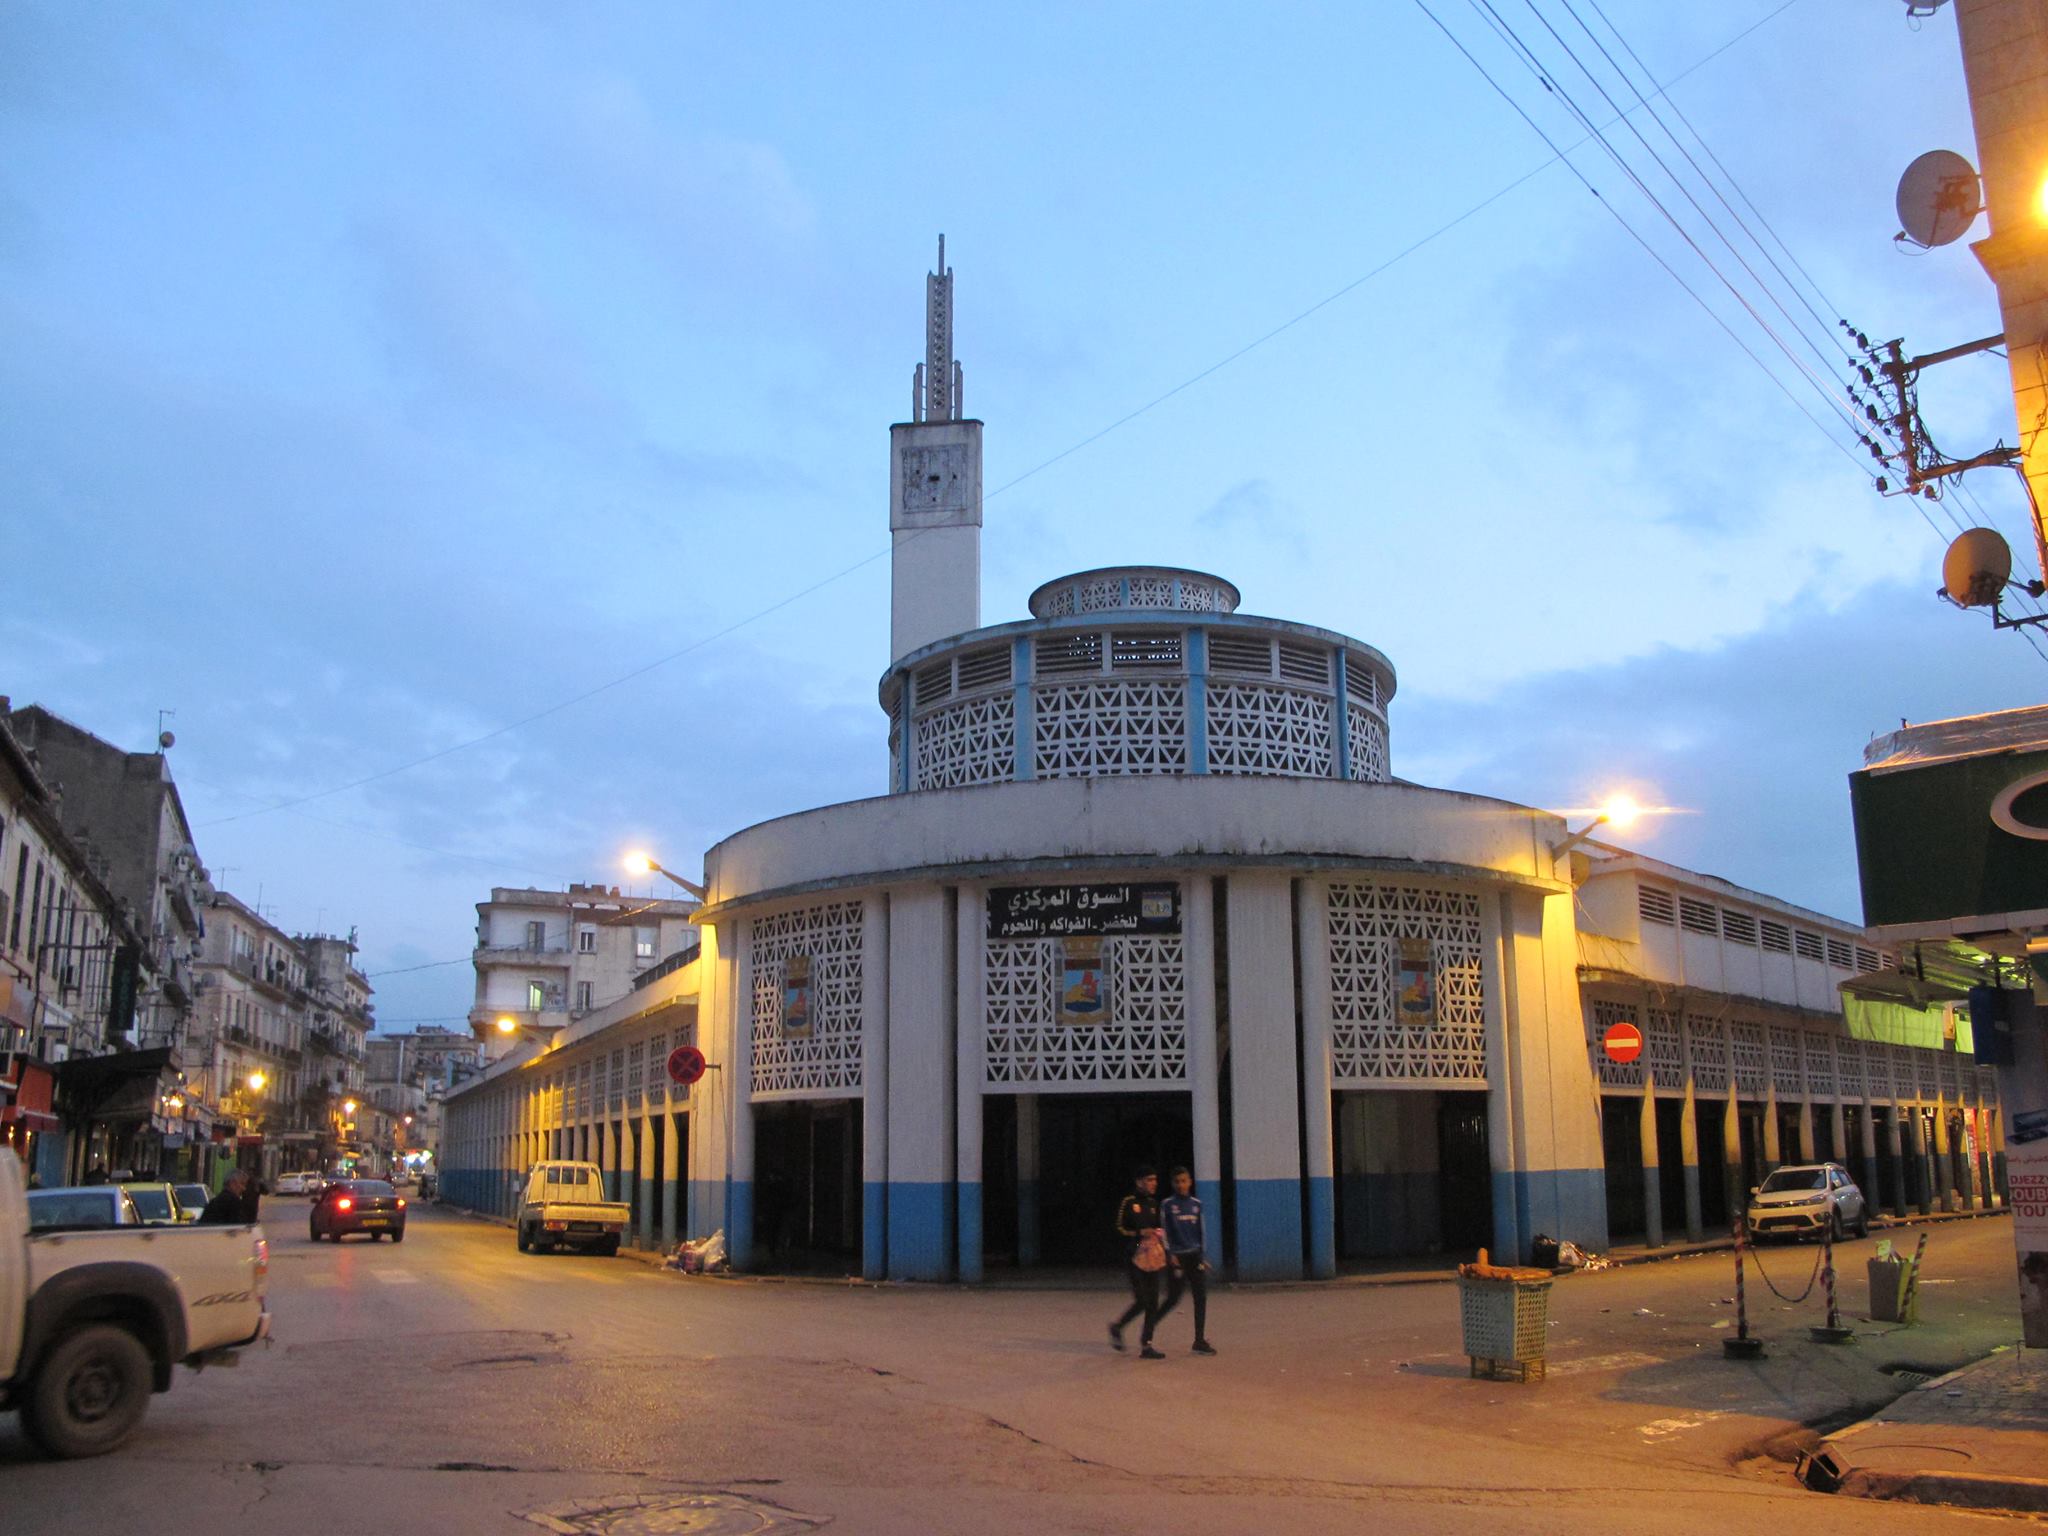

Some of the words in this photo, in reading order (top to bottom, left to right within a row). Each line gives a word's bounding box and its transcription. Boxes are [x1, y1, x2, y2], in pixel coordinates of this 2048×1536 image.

[1008, 888, 1070, 916] المركزي
[1077, 887, 1129, 909] السوق
[2009, 1188, 2048, 1201] OUB
[2016, 1204, 2048, 1217] TOU
